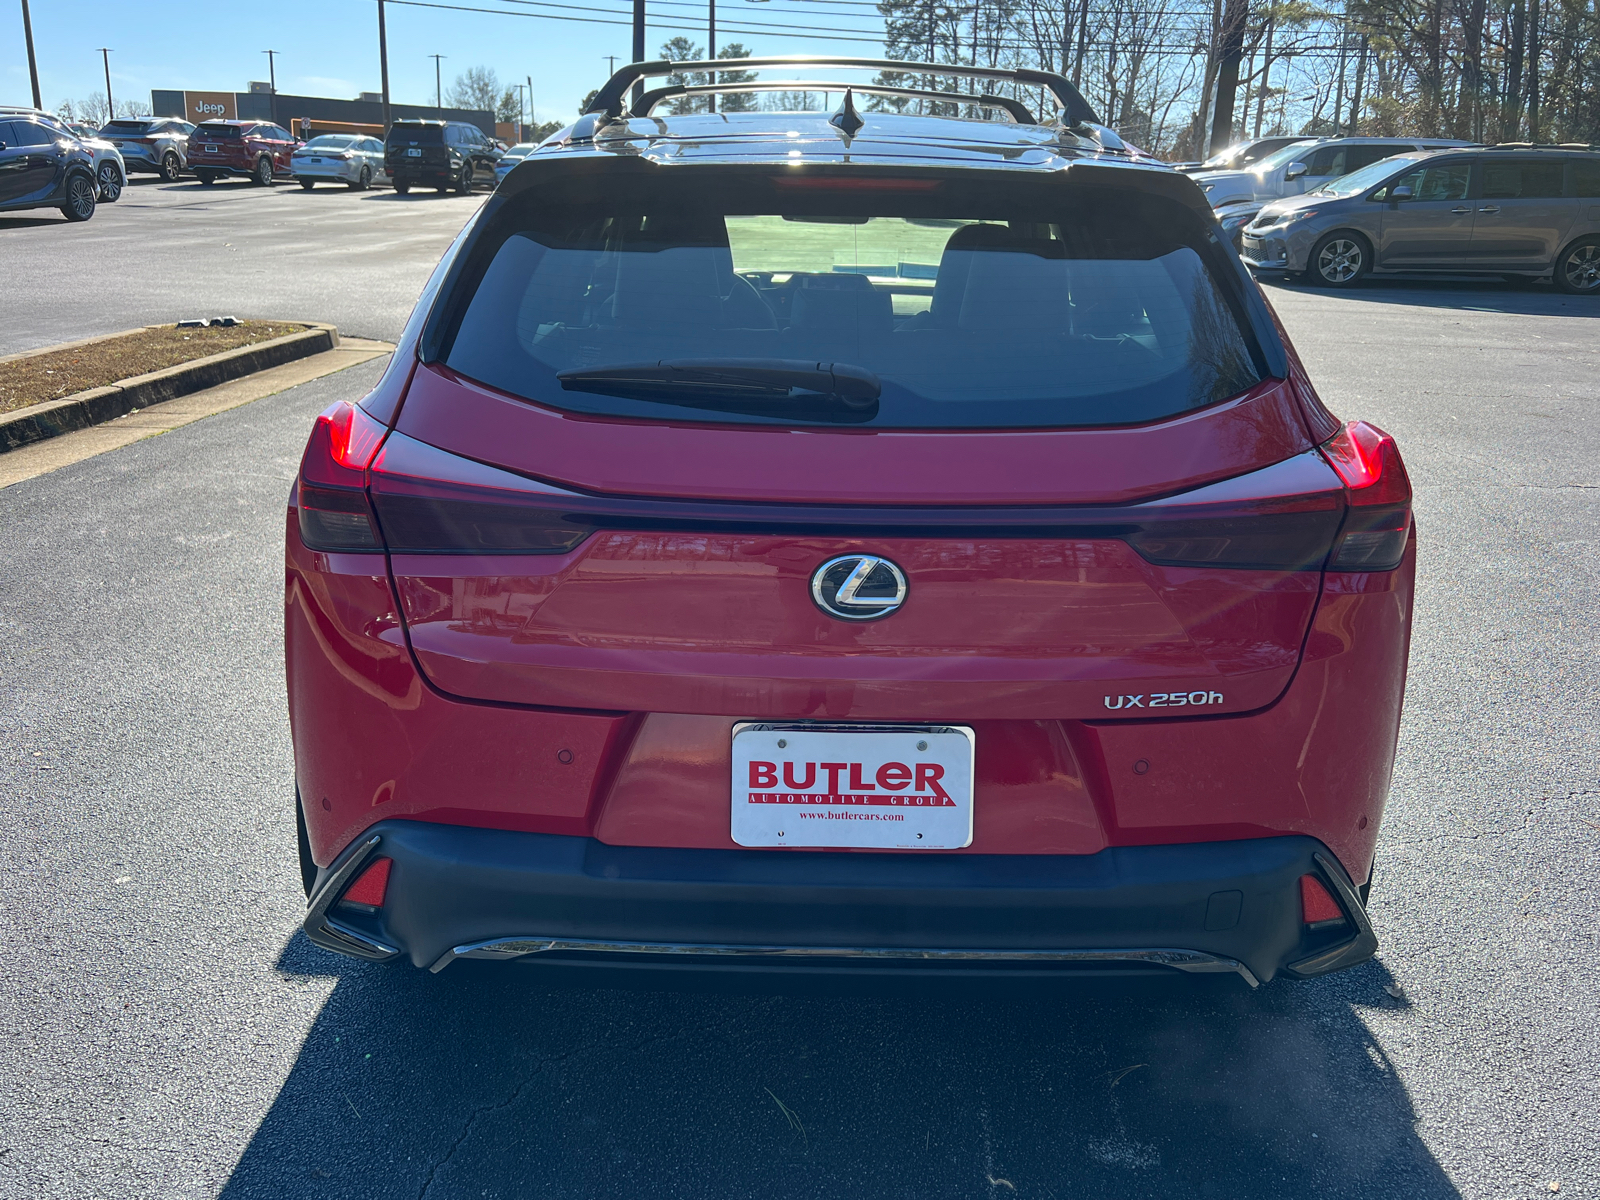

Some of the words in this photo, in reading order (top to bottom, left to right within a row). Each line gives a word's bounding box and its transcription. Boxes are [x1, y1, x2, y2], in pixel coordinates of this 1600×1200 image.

[195, 100, 226, 116] Jeep
[1104, 694, 1145, 710] UX
[1148, 690, 1224, 707] 250h
[749, 793, 870, 805] AUTOMOTIVE
[890, 796, 950, 806] GROUP
[799, 811, 905, 822] www.butlercars.com
